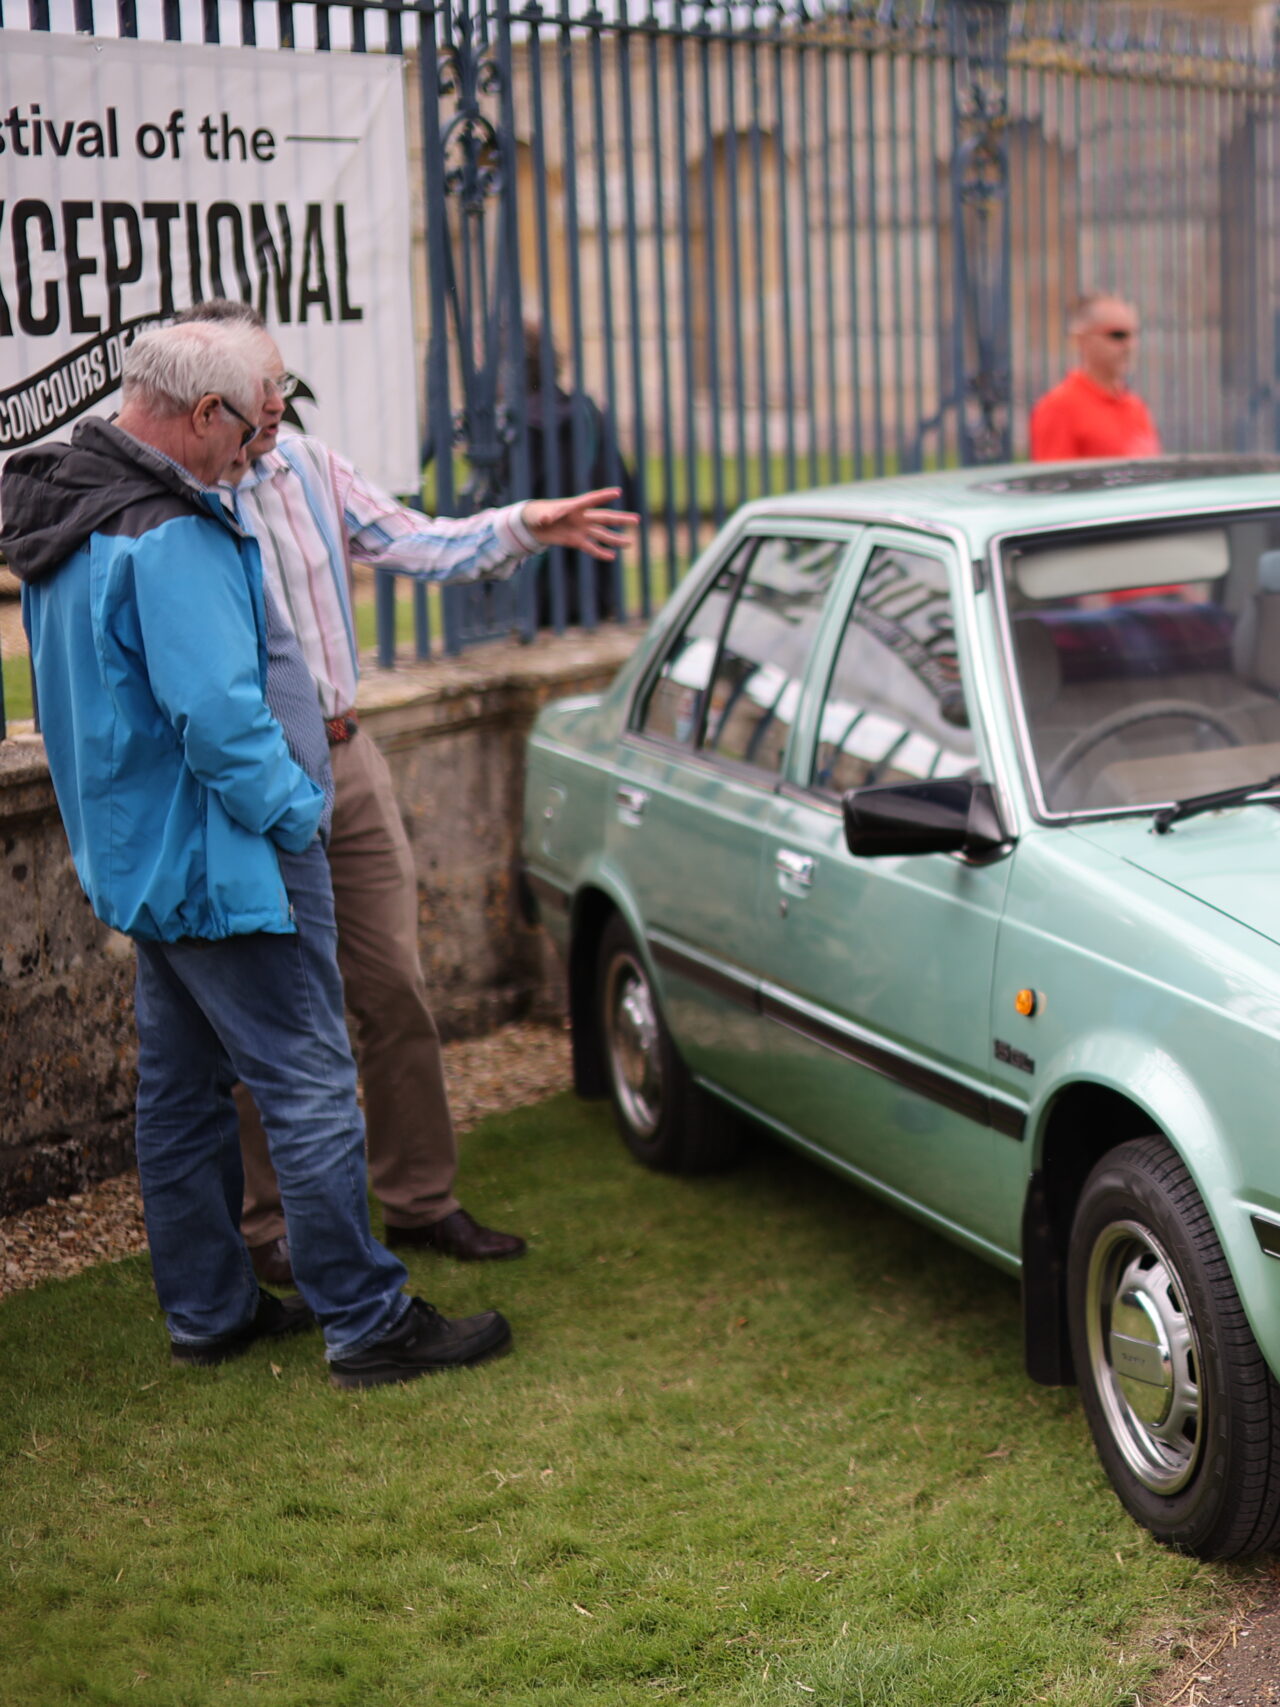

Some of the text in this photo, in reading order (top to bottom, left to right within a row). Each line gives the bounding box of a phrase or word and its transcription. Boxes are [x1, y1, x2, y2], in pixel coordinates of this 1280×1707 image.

[0, 104, 276, 161] tival of the
